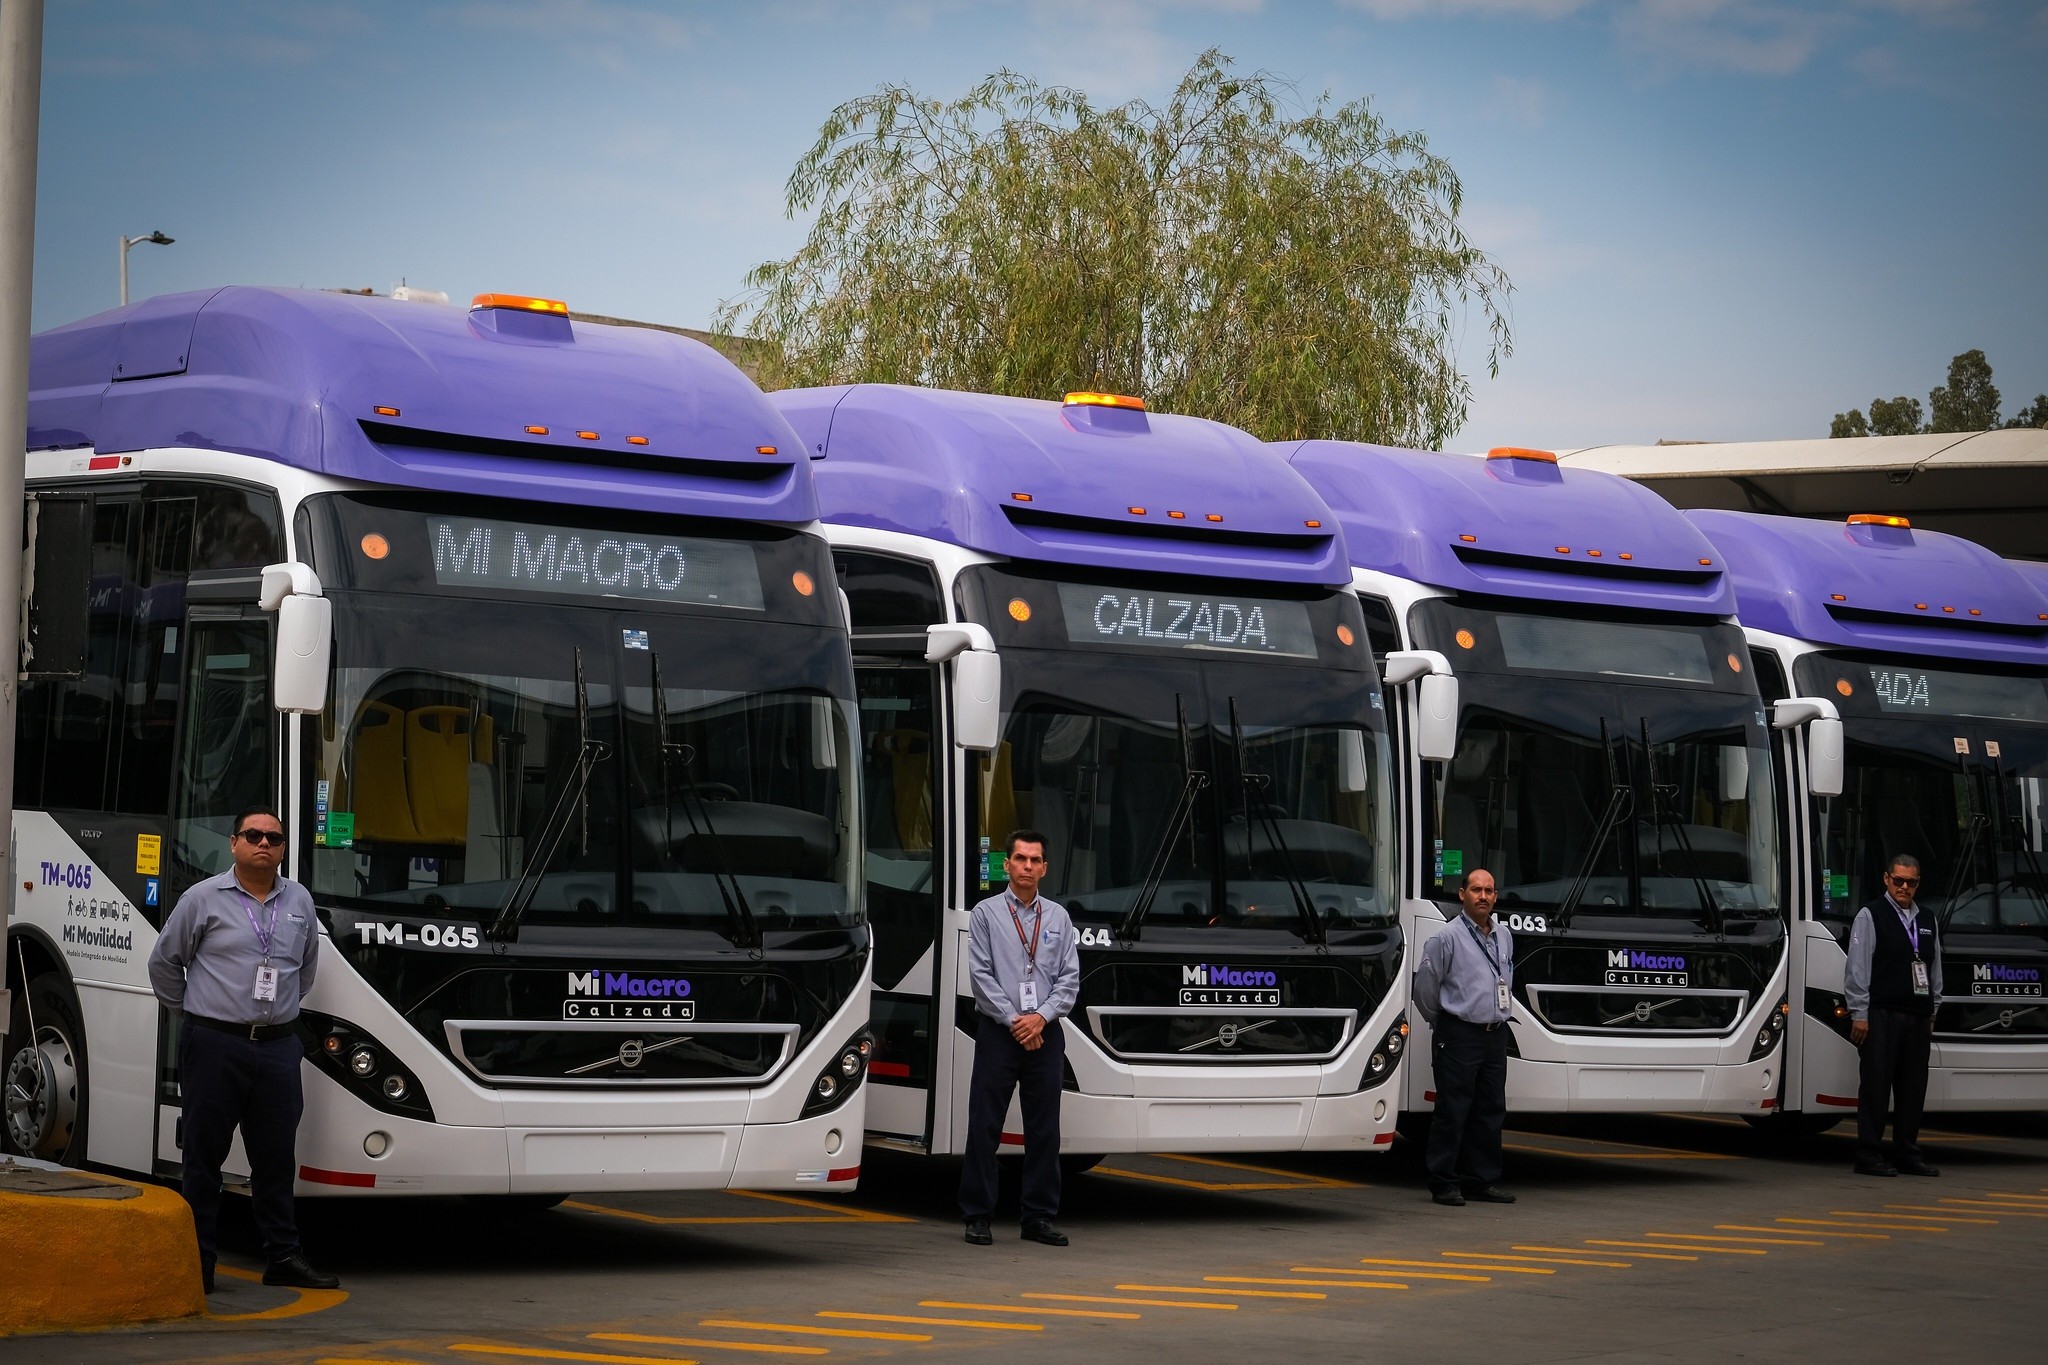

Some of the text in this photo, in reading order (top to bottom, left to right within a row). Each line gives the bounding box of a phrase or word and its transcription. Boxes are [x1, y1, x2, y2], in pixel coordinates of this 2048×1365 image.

[436, 524, 686, 591] MI MACRO
[1093, 594, 1267, 646] CALZADA
[1869, 671, 1930, 707] ADA
[40, 861, 92, 890] TM-065
[62, 923, 132, 951] Mi Movilidad
[354, 922, 480, 949] TM-065
[1607, 948, 1686, 970] Mi Macro
[1973, 962, 2039, 981] Mi Macro
[568, 969, 692, 997] Mi Macro
[1182, 963, 1277, 987] Mi Macro
[1608, 973, 1686, 985] Calzada
[1183, 991, 1277, 1003] Calzada
[1974, 984, 2040, 994] Calzada
[568, 1003, 691, 1017] Calzada
